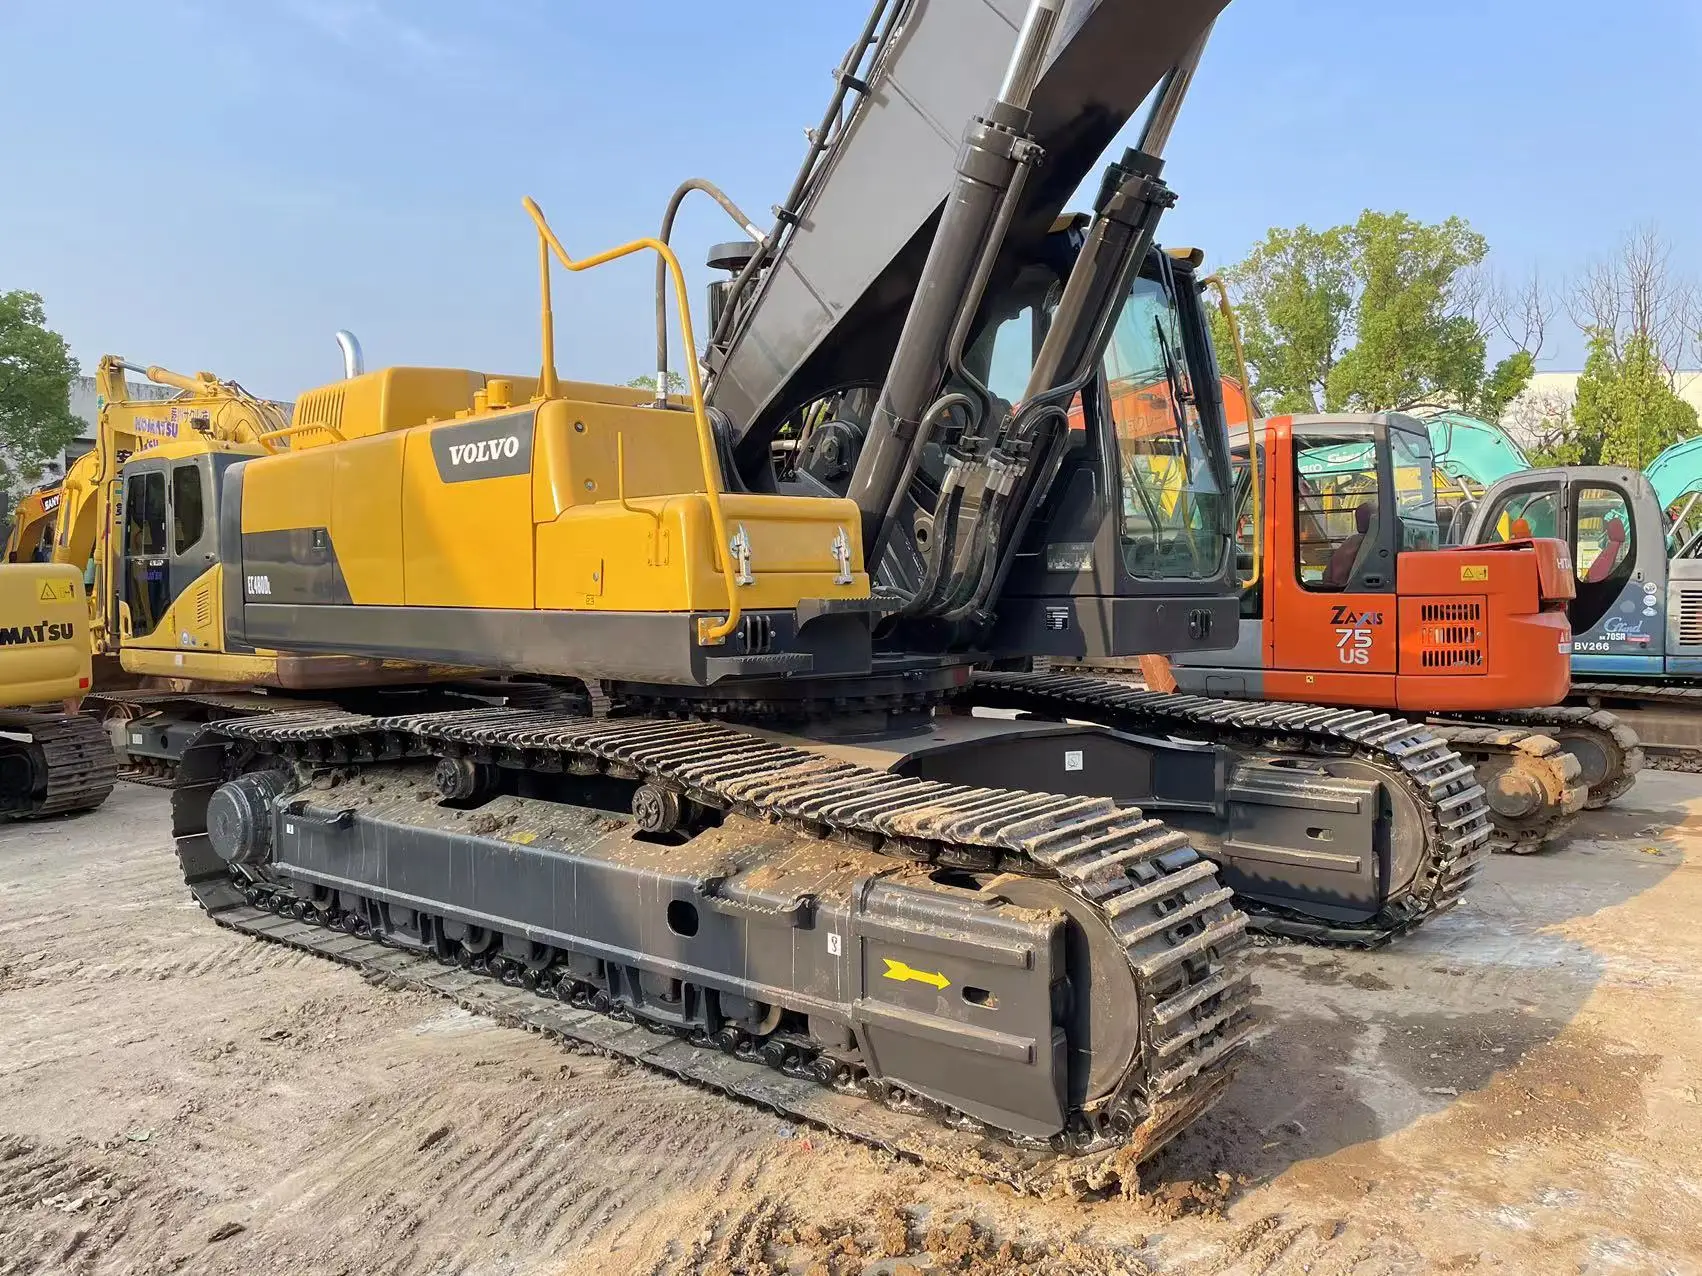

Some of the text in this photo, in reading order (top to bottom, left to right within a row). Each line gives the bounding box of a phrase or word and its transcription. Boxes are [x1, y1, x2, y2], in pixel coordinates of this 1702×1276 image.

[449, 436, 519, 465] VOLVO
[44, 494, 60, 511] SANY
[1330, 605, 1383, 626] ZAXIS
[0, 620, 74, 645] MATSU
[1335, 628, 1373, 648] 75
[1340, 648, 1369, 664] US
[1574, 642, 1610, 651] BV266
